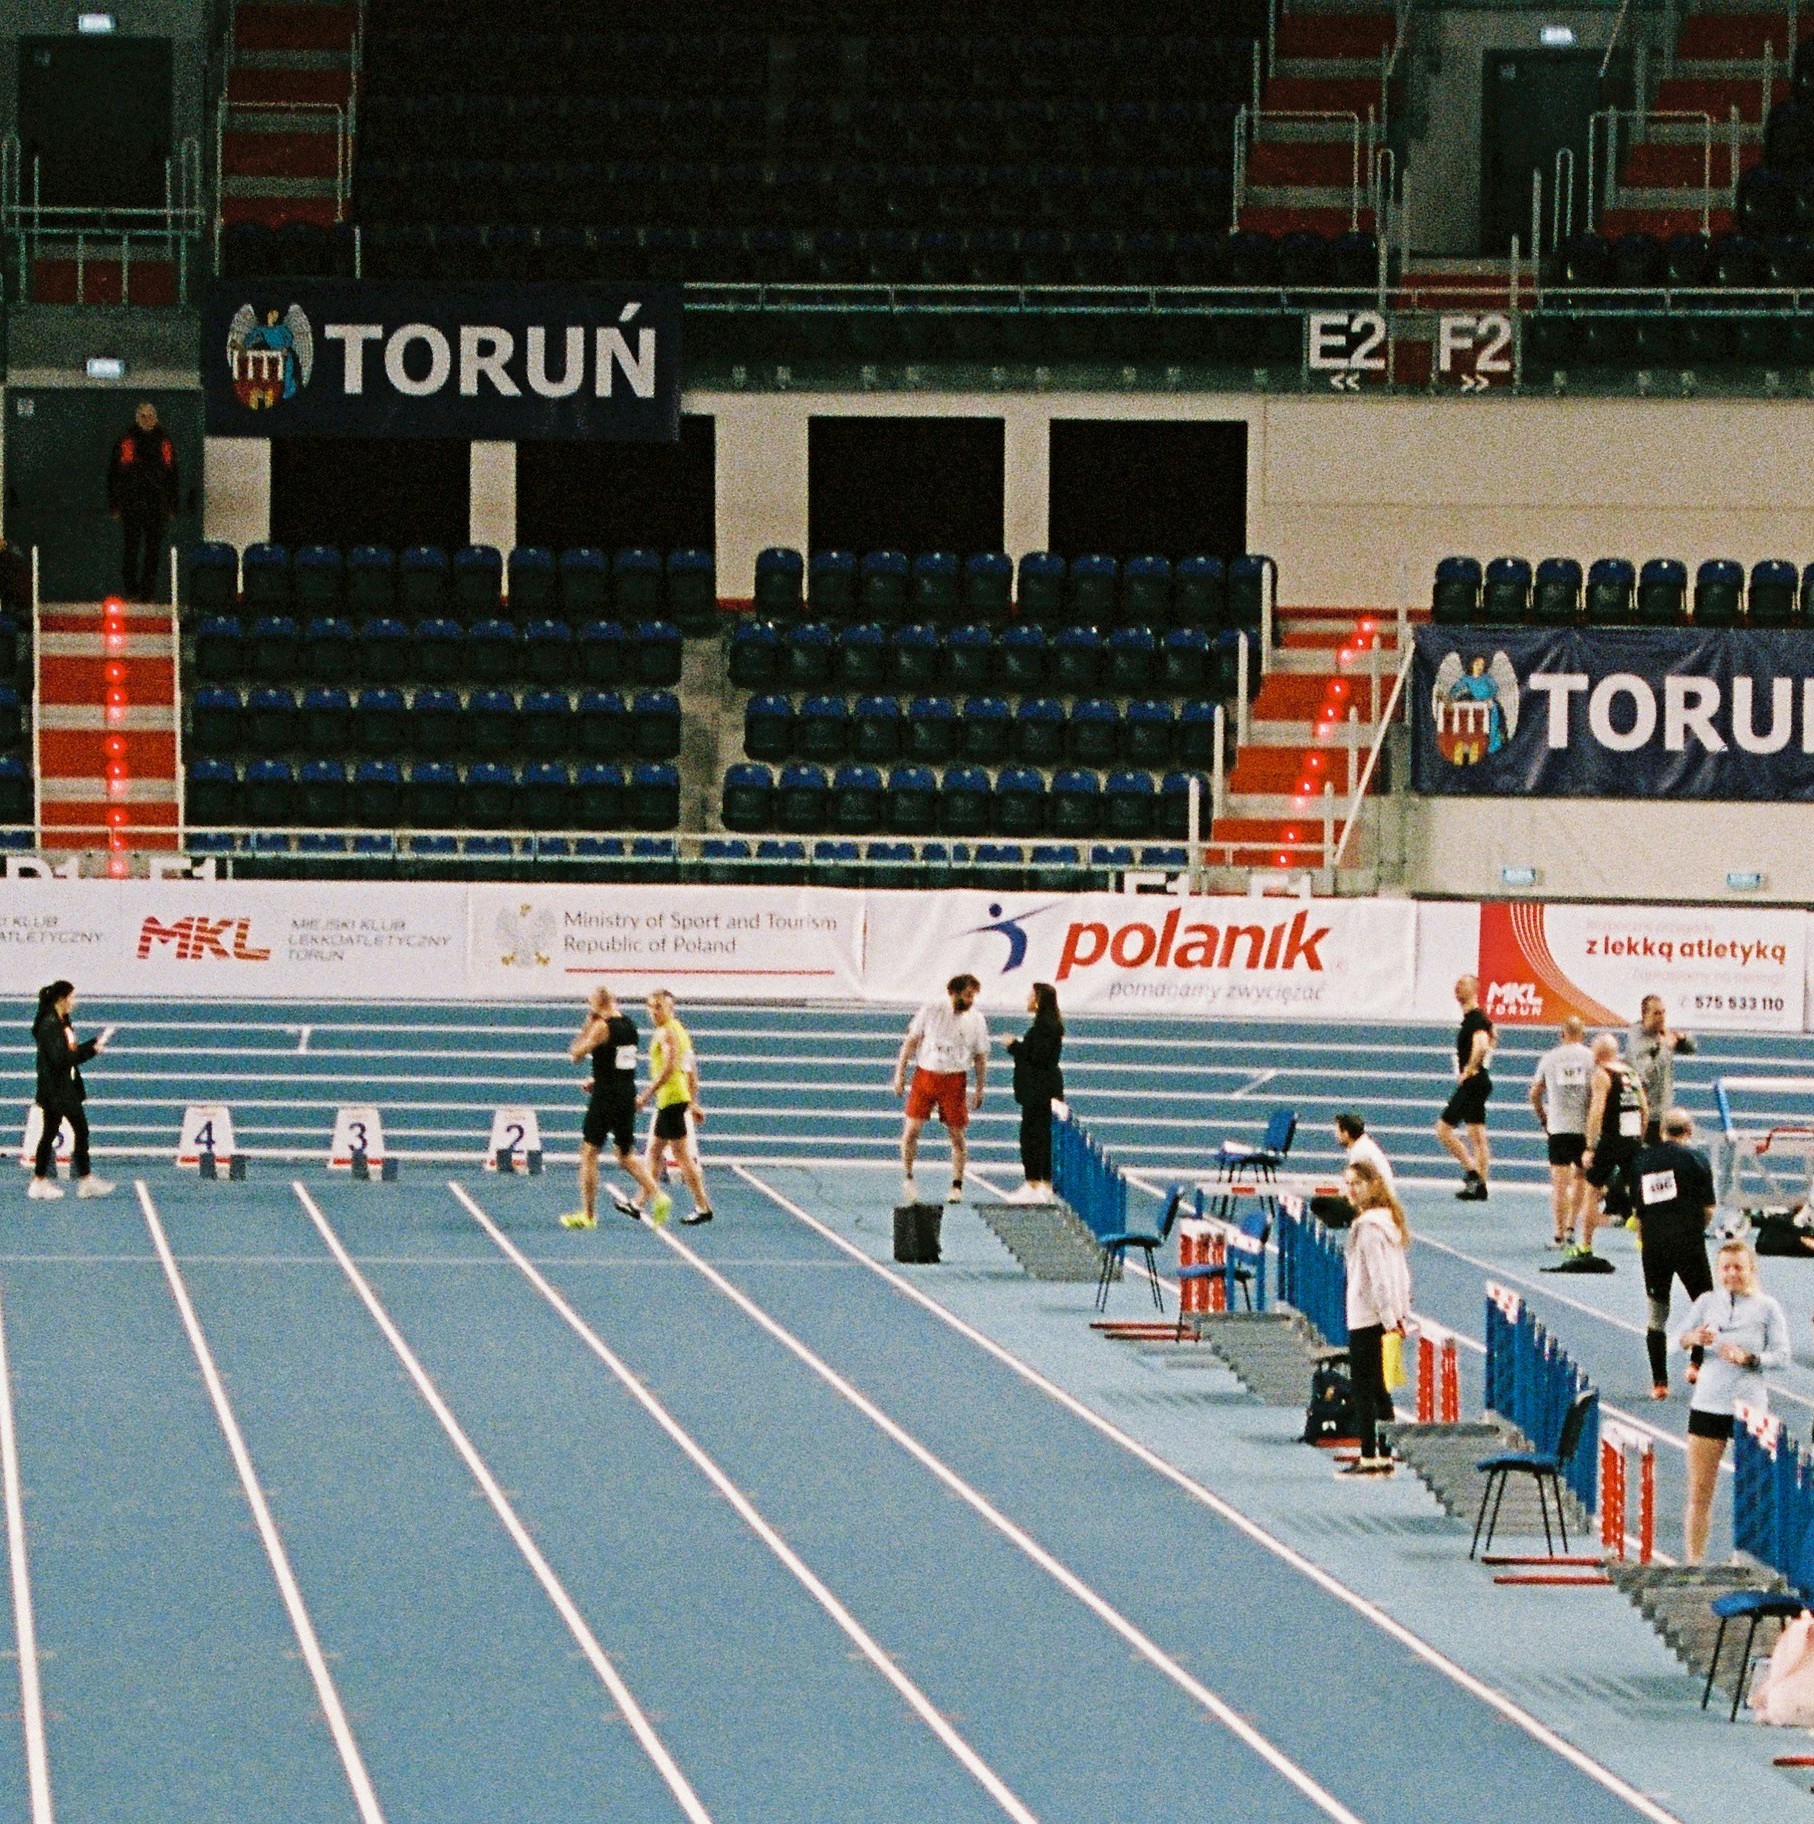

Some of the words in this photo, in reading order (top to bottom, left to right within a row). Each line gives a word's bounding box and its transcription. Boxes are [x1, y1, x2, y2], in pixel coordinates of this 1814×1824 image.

[325, 302, 656, 398] TORUŃ
[1309, 312, 1386, 371] E2
[1439, 313, 1512, 373] F2
[564, 911, 639, 931] Ministry
[646, 911, 664, 929] of
[671, 911, 719, 931] Sport
[727, 912, 760, 930] and
[768, 912, 838, 931] Tourism
[137, 916, 270, 961] MKL
[564, 936, 639, 955] Republic
[649, 936, 666, 953] of
[673, 937, 737, 955] Poland
[1055, 907, 1332, 982] polanik
[1585, 939, 1598, 955] z
[1604, 935, 1674, 963] lekką
[1680, 938, 1787, 967] atletyką
[194, 1120, 216, 1153] 4
[347, 1121, 369, 1152] 3
[504, 1123, 526, 1154] 2
